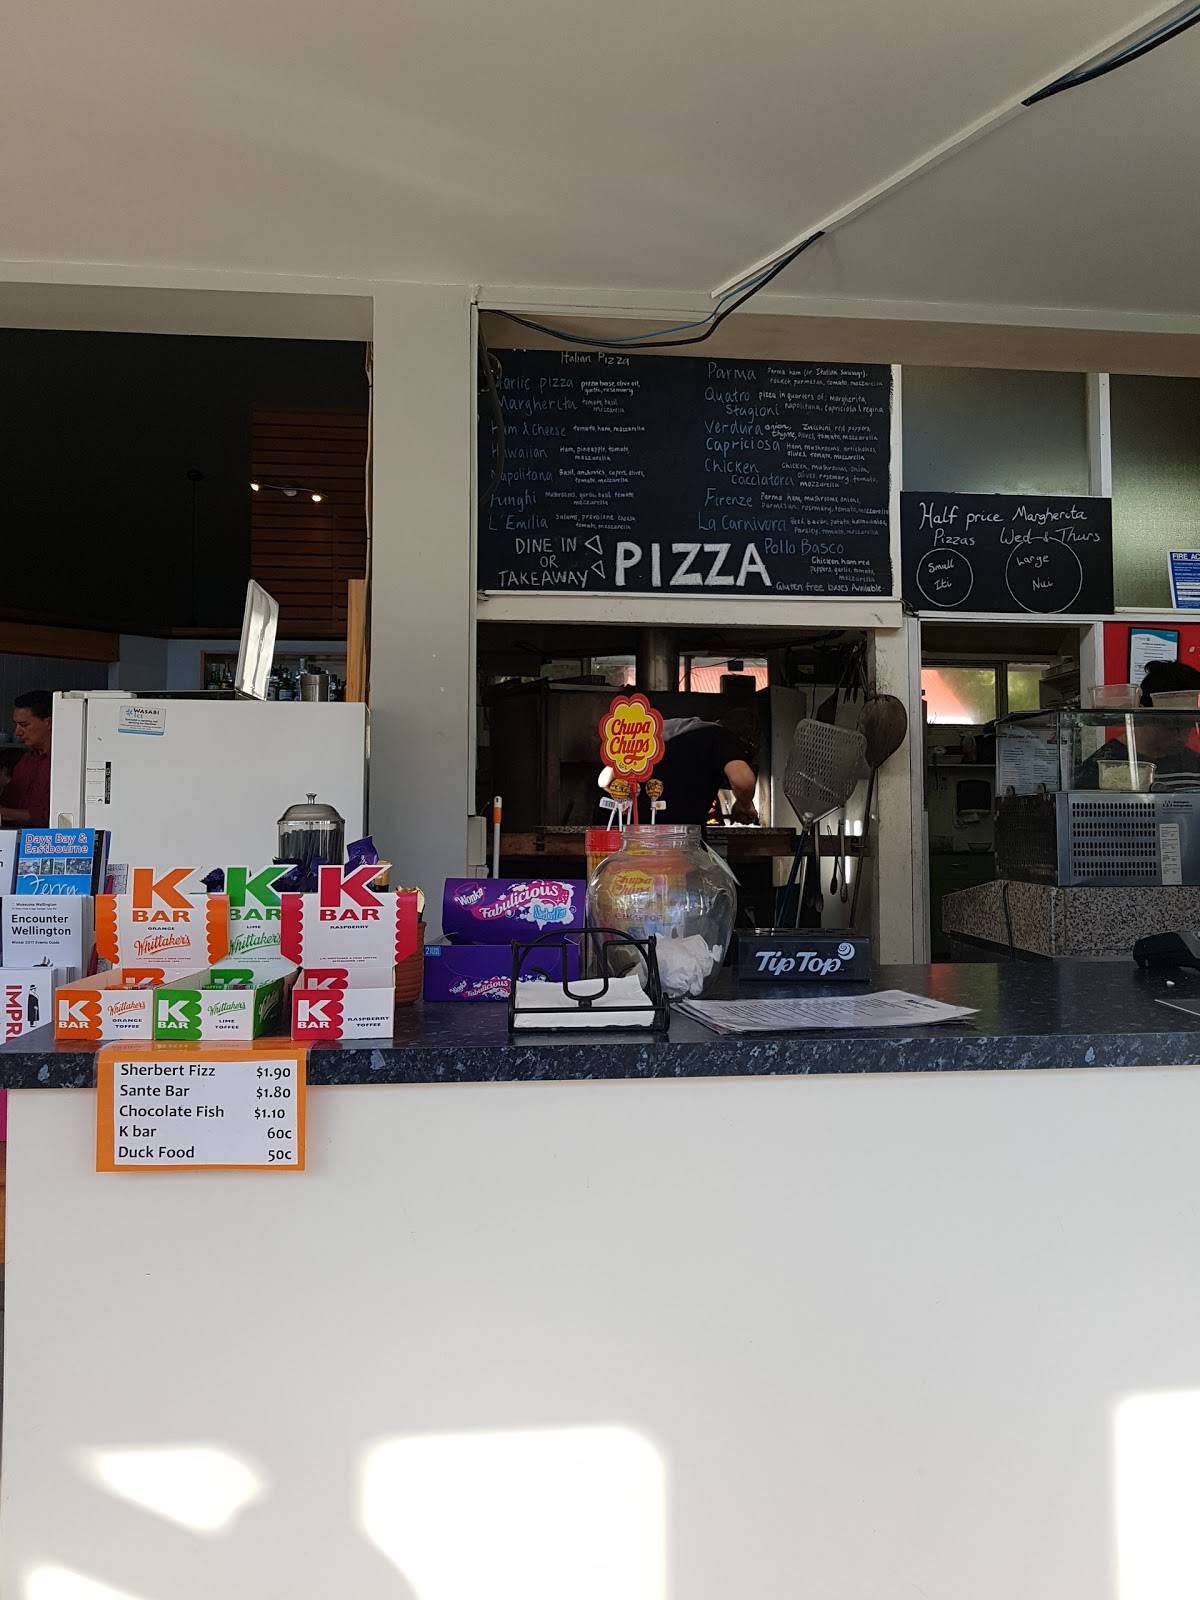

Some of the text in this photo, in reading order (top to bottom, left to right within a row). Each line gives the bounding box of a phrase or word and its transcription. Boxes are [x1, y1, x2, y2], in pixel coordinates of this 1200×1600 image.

[598, 352, 631, 367] Pizza
[708, 361, 758, 381] Parma
[539, 377, 574, 395] pizza
[704, 386, 752, 403] Quatro
[726, 403, 780, 425] Stagioni
[704, 420, 765, 436] Verdura
[706, 437, 781, 459] Capriciosa
[704, 457, 760, 475] Chicken
[704, 487, 753, 508] Firenze
[698, 511, 787, 533] La Carnivora
[919, 502, 1088, 532] Half price Margherita
[515, 537, 577, 555] DINE IN
[934, 528, 977, 547] Pizzas
[1000, 527, 1032, 546] Wed
[1056, 527, 1101, 544] Thurs
[764, 537, 845, 556] Pollo Basco
[540, 554, 559, 568] OR
[615, 541, 773, 588] PIZZA
[1017, 555, 1051, 569] Large
[1172, 552, 1188, 561] FIRE
[928, 558, 956, 574] Small
[498, 570, 589, 589] TAKEAWAY
[934, 579, 952, 591] Iti
[1033, 578, 1054, 591] Nui
[611, 718, 651, 741] Chupa
[610, 736, 650, 758] Chups
[25, 833, 53, 847] Days
[55, 833, 77, 847] Bay
[25, 843, 89, 855] Eastbourne
[132, 868, 196, 909] K
[227, 867, 290, 907] K
[320, 867, 386, 907] K
[478, 883, 560, 920] Fabulicious
[11, 914, 69, 924] Encounter
[132, 910, 191, 923] BAR
[229, 908, 281, 921] BAR
[320, 909, 380, 921] BAR
[11, 926, 72, 938] Wellington
[58, 999, 91, 1022] K
[157, 999, 190, 1022] K
[297, 999, 333, 1022] K
[58, 1021, 89, 1029] BAR
[157, 1021, 189, 1029] BAR
[297, 1021, 330, 1029] BAR
[120, 1063, 291, 1081] Sherbert Fizz $1.90
[119, 1084, 292, 1100] Sante Bar $1.80
[119, 1104, 286, 1120] Chocolate Fish $1.10
[119, 1124, 292, 1140] K bar 60c
[118, 1145, 292, 1163] Duck Food 50c
